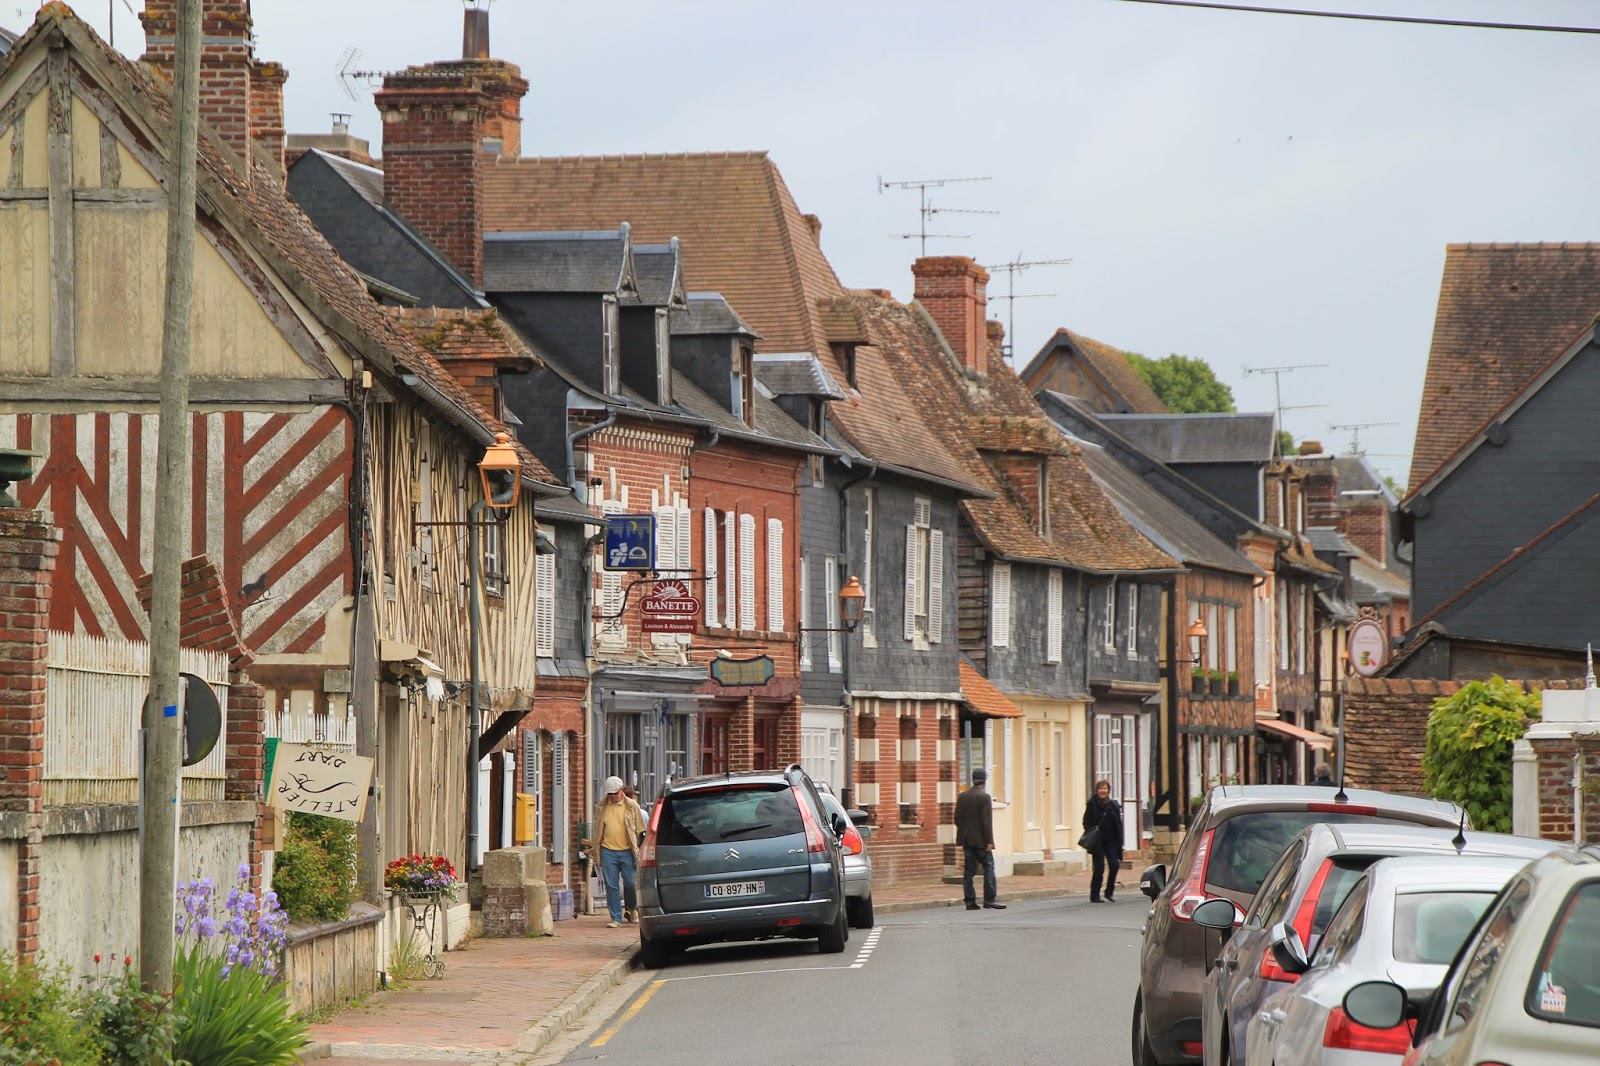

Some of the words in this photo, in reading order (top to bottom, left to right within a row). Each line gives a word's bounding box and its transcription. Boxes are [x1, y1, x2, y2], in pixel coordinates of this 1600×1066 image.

[645, 600, 694, 611] BANETTE
[294, 751, 347, 768] D'ART
[278, 779, 361, 814] ATELIER
